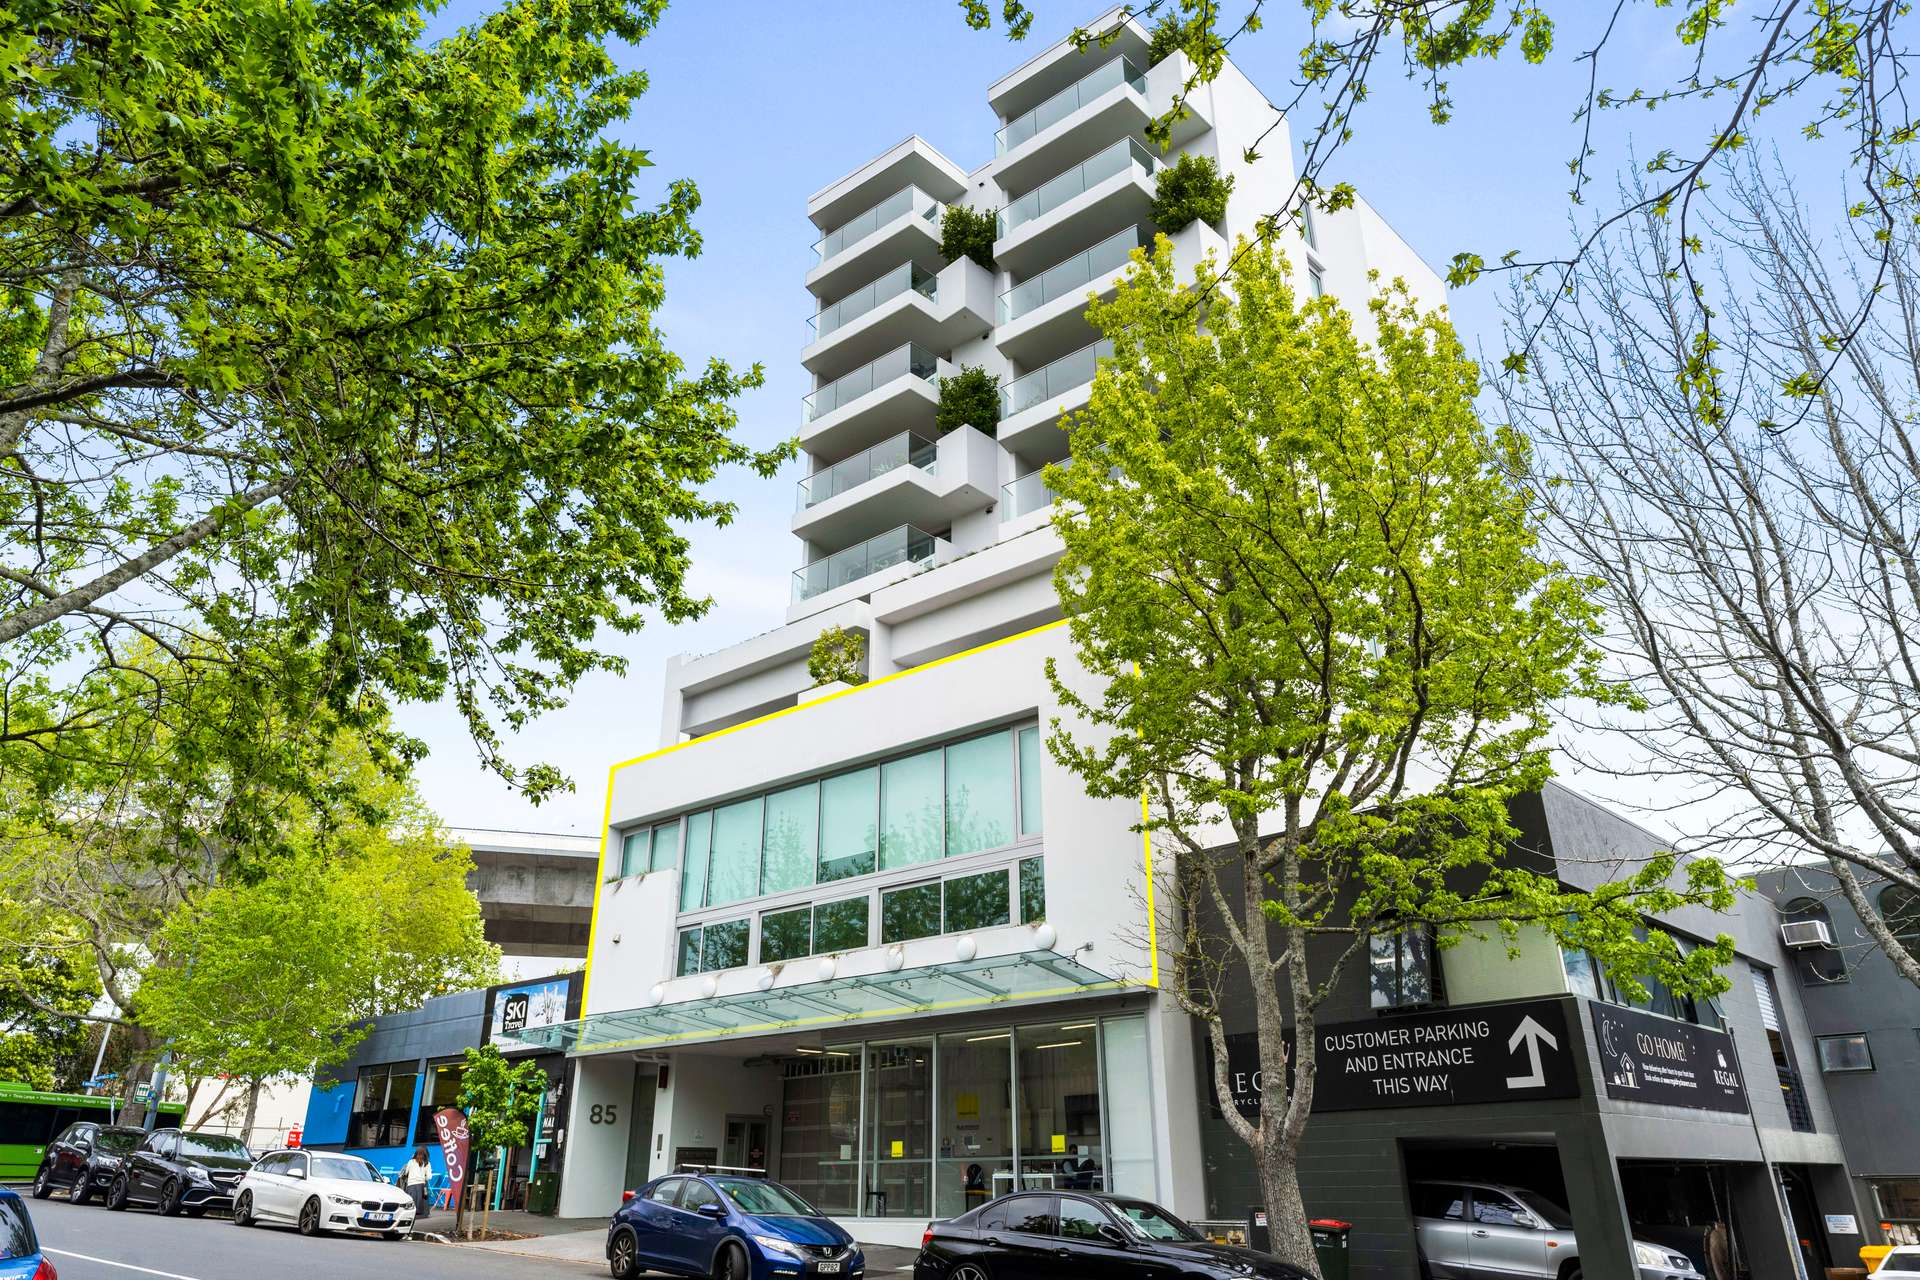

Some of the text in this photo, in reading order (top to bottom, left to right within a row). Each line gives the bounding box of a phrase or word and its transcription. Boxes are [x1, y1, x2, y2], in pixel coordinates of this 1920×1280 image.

[505, 1000, 527, 1021] SKI
[504, 1019, 524, 1031] Travel
[1324, 1021, 1490, 1052] CUSTOMER PARKING
[1636, 1032, 1688, 1062] GO HOME!
[1345, 1047, 1475, 1074] AND ENTRANCE
[1373, 1074, 1449, 1096] THIS WAY
[1712, 1069, 1739, 1088] REGAL
[589, 1104, 618, 1125] 85
[436, 1114, 464, 1182] Coffee
